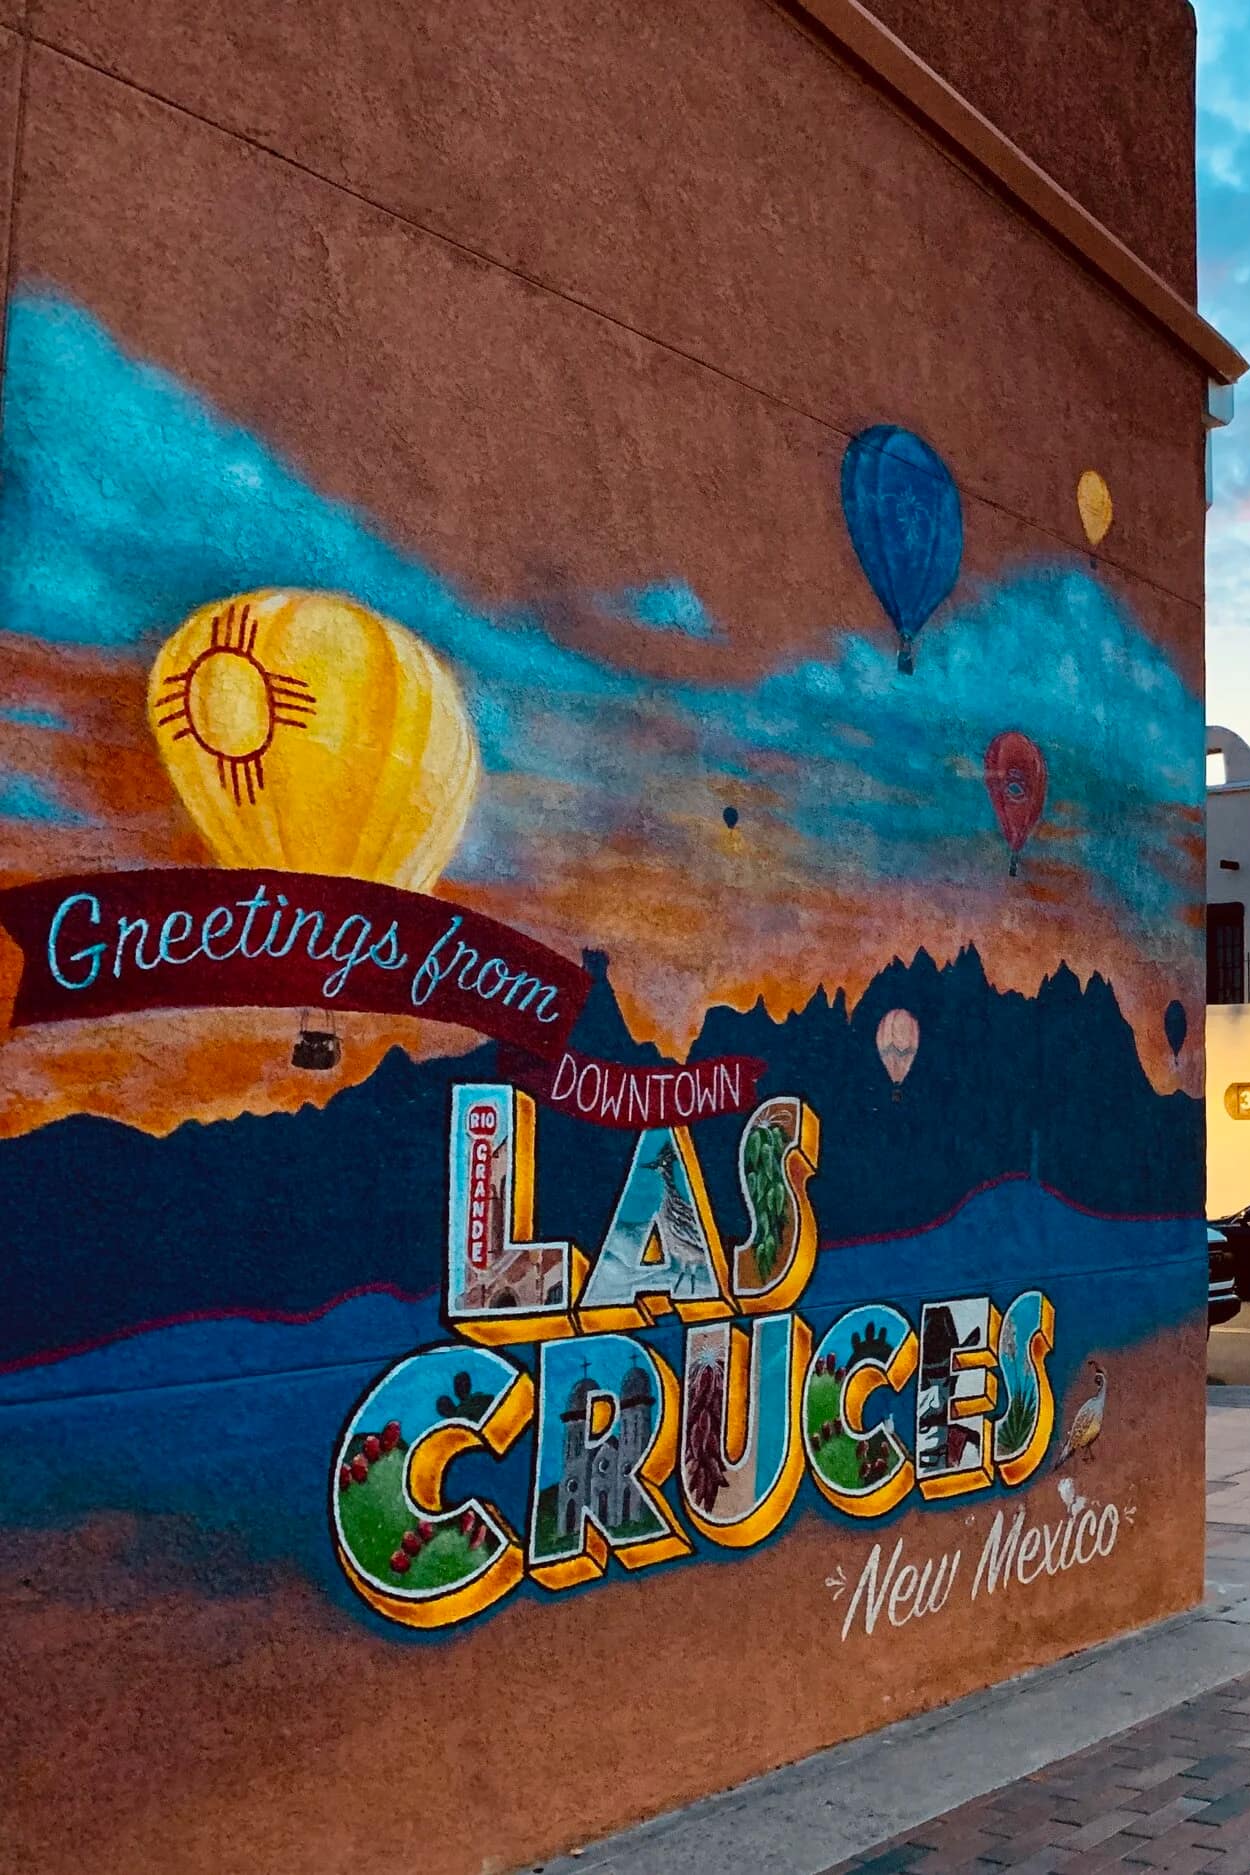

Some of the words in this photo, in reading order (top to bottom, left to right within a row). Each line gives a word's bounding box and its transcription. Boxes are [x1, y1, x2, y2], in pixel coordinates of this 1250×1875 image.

[48, 885, 408, 997] Greetings
[411, 916, 559, 1023] from
[470, 1112, 495, 1130] RIO
[551, 1052, 742, 1123] DOWNTOWN
[444, 1082, 822, 1347] LAS
[470, 1143, 489, 1263] GRANDE
[328, 1288, 1056, 1630] CRUCES
[841, 1537, 961, 1643] New
[971, 1502, 1120, 1601] Mexico
